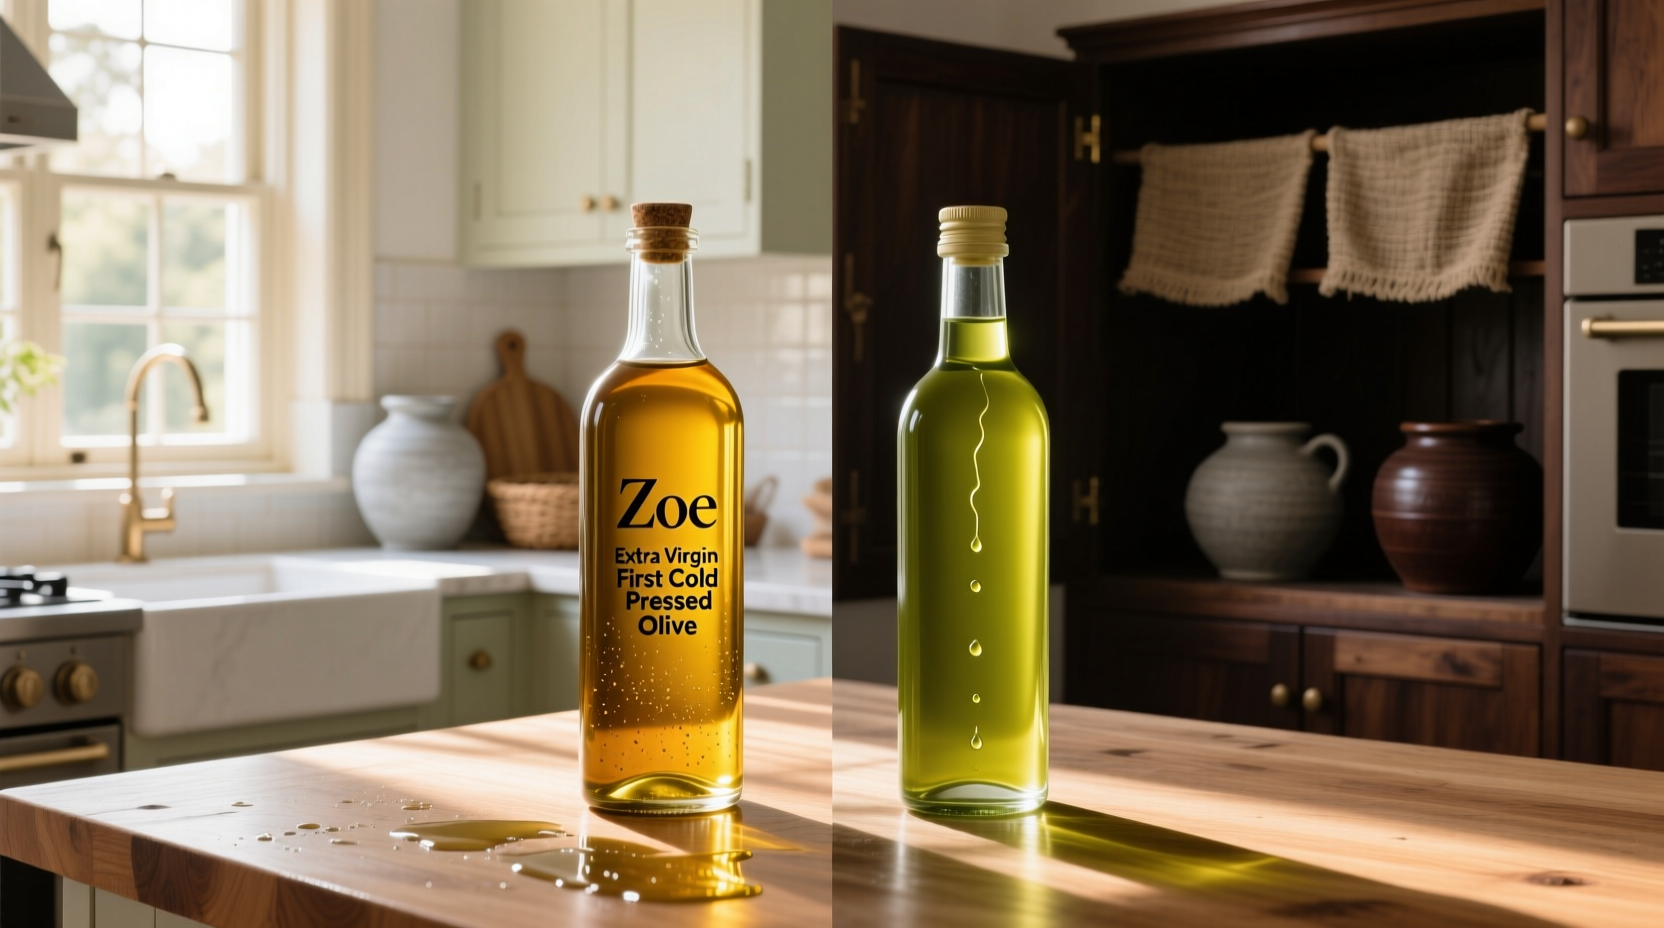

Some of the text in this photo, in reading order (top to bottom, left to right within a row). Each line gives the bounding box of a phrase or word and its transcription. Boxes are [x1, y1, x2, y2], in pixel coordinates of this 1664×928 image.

[617, 478, 717, 529] Zoe
[615, 547, 718, 567] Extra Virgin
[617, 567, 718, 588] First Cold
[626, 590, 712, 610] Pressed
[638, 615, 697, 635] Olive
